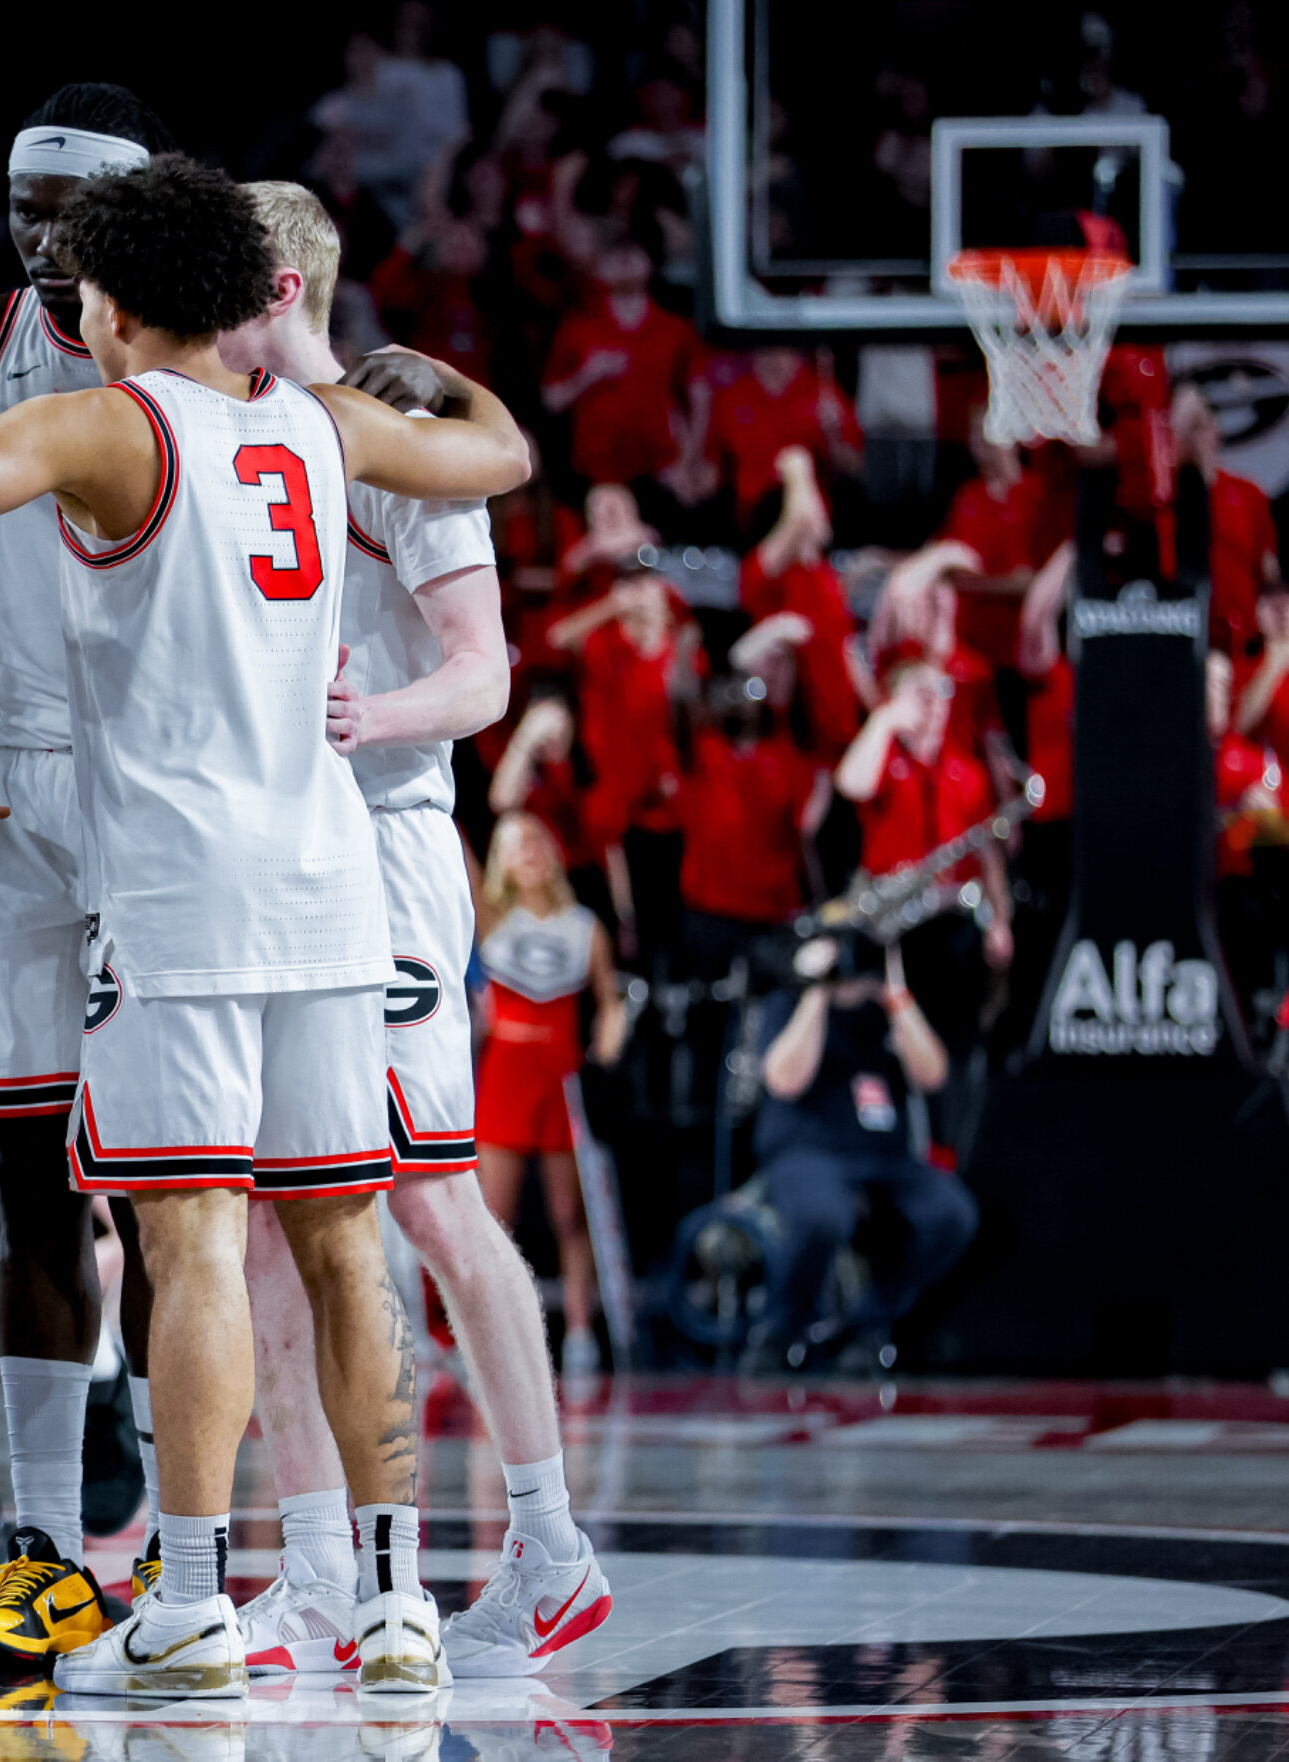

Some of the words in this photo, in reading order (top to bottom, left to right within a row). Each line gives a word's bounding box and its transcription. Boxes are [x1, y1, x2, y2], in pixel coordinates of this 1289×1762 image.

[232, 443, 324, 601] 3
[1051, 939, 1218, 1023] Alfa
[1049, 1020, 1218, 1055] Insurance
